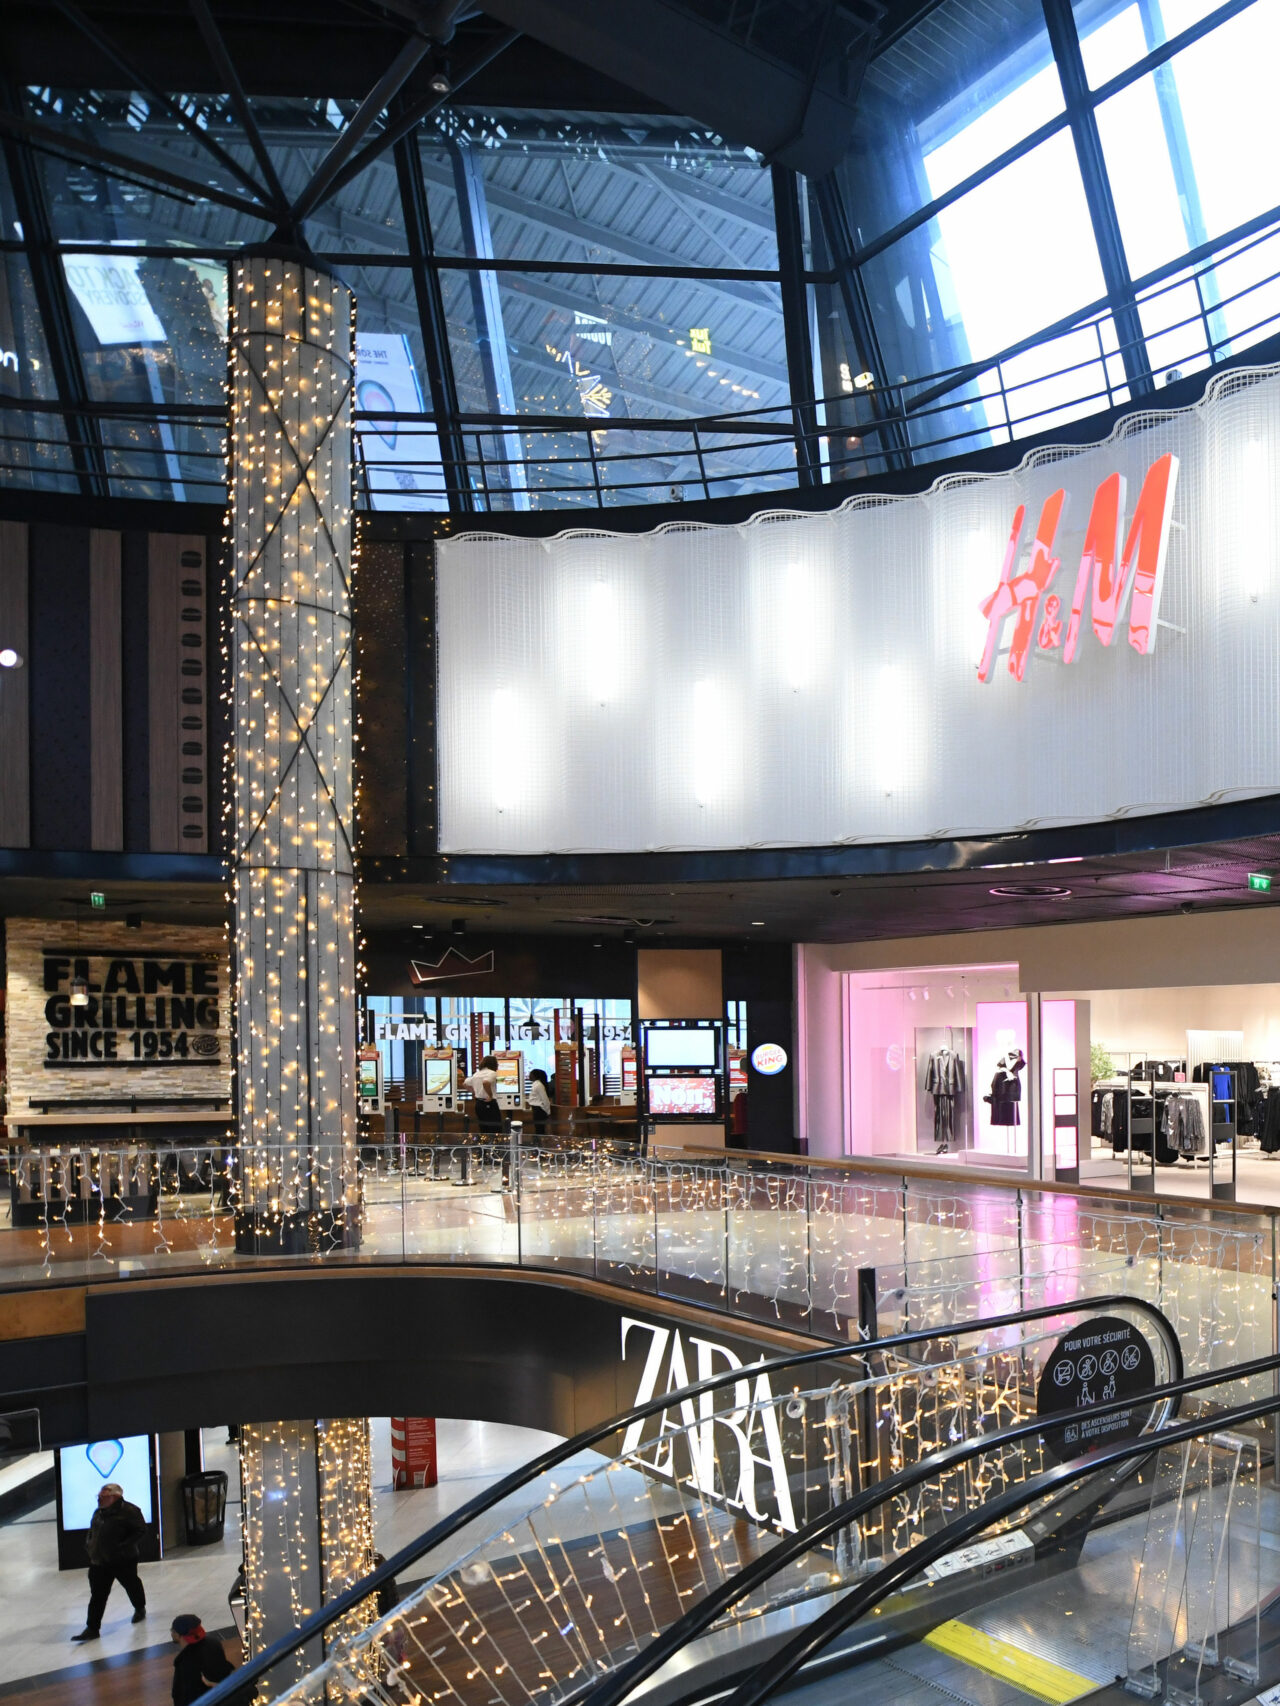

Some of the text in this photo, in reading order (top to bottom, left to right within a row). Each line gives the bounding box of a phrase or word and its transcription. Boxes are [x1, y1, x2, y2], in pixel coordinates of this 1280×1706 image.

[977, 452, 1180, 684] H&M
[43, 957, 220, 995] FLAME
[44, 994, 220, 1030] GRILLING
[46, 1030, 118, 1059] SINCE
[129, 1031, 190, 1058] 1954
[375, 1023, 437, 1040] FLAME
[757, 1054, 783, 1067] KING
[1064, 1326, 1130, 1351] POUR VOTRE SÉCURITÉ
[621, 1316, 799, 1534] ZARA
[1081, 1409, 1133, 1430] DES ASCENSEURS SONT
[1085, 1427, 1100, 1438] VOTRE
[1101, 1419, 1129, 1434] DISPOSITION
